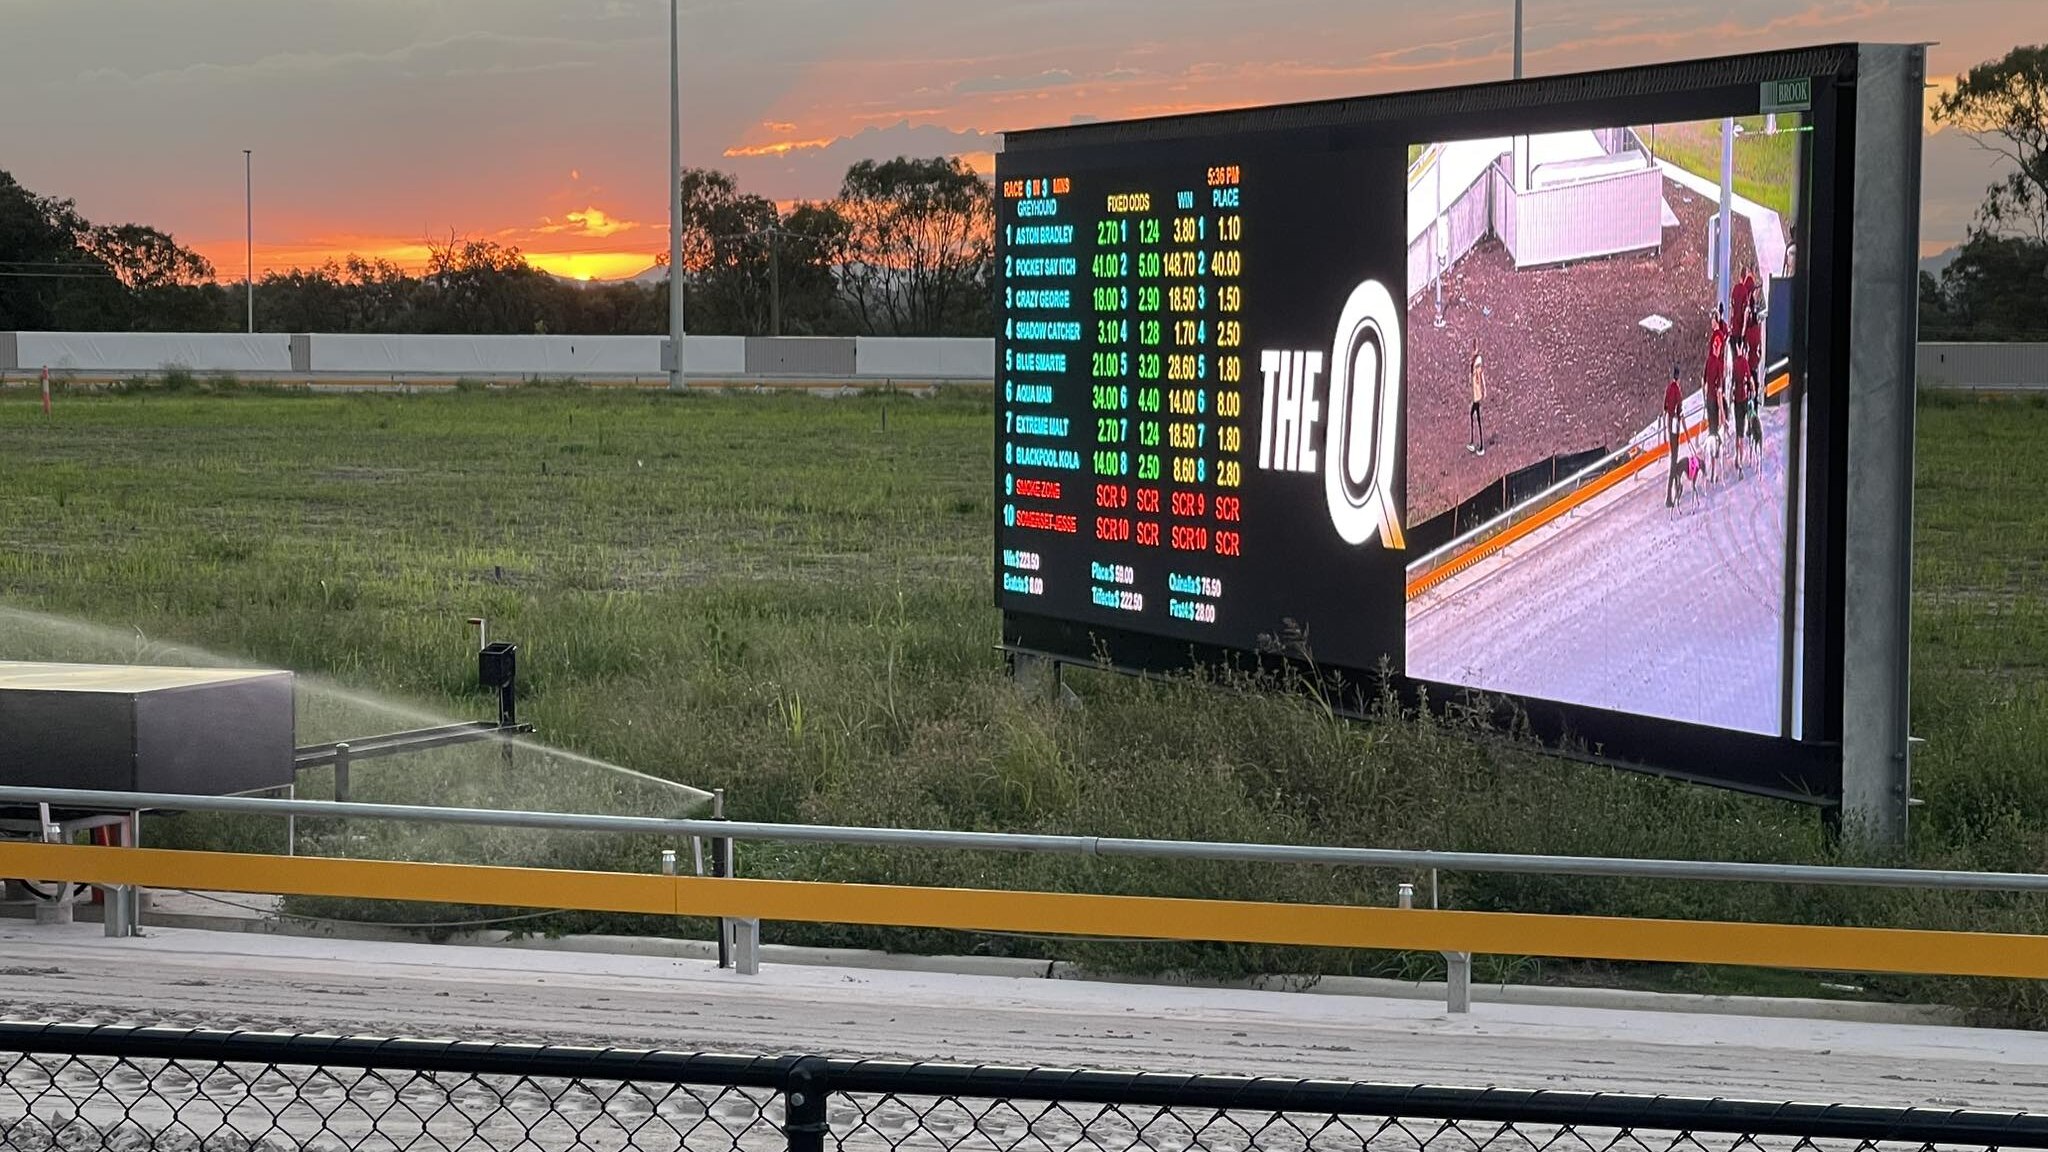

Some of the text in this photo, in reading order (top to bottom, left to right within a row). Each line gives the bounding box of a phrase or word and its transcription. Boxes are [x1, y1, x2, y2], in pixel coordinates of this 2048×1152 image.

[1779, 82, 1807, 102] BROOK
[1004, 180, 1023, 197] RACE
[1026, 180, 1031, 198] 6
[1042, 178, 1048, 198] 3
[1208, 166, 1240, 185] 5:36 PM
[1018, 199, 1056, 217] GREYHOUND
[1108, 193, 1149, 212] FIXED ODDS
[1178, 191, 1193, 208] WIN
[1213, 188, 1239, 207] PLACE
[1006, 215, 1240, 246] 1 ASTON BRADLEY 2.70 1 1.24 3.80 1 1.10
[1005, 251, 1240, 278] 2 POCKET SAY ITCH 41.00 2 5.00 148.70 2 40.00
[1006, 286, 1240, 311] 3 CRAZY GEORGE 18.00 3 2.90 18.50 3 1.50
[1005, 318, 1240, 346] 4 SHADOW CATCHER 3.10 4 1.28 1.70 4 2.50
[1006, 349, 1012, 371] 5
[1016, 353, 1035, 371] BLUE
[1093, 353, 1118, 377] 21.00
[1121, 352, 1127, 375] 5
[1139, 354, 1159, 378] 3.20
[1168, 355, 1195, 380] 28.60
[1198, 354, 1205, 378] 5
[1218, 356, 1240, 381] 1.80
[1006, 380, 1012, 402] 6
[1016, 385, 1036, 402] AQUA
[1093, 385, 1118, 410] 34.00
[1120, 386, 1127, 409] 6
[1138, 388, 1159, 412] 4.40
[1169, 390, 1195, 414] 14.00
[1198, 389, 1205, 413] 6
[1218, 391, 1240, 417] 8.00
[1258, 279, 1406, 550] THE Q
[1006, 411, 1012, 433] 7
[1016, 415, 1049, 435] EXTREME
[1098, 418, 1118, 442] 2.70
[1120, 418, 1127, 441] 7
[1140, 421, 1159, 445] 1.24
[1169, 423, 1195, 448] 18.50
[1198, 423, 1205, 447] 7
[1218, 426, 1240, 452] 1.80
[1006, 442, 1240, 487] 8 BLACKPOOL KOLA 14.00 8 2.50 8.60 8 2.80
[1006, 473, 1012, 495] 9
[1097, 484, 1119, 508] SCR
[1120, 486, 1127, 507] 9
[1137, 488, 1159, 512] SCR
[1172, 492, 1196, 516] SCR
[1197, 493, 1205, 515] 9
[1216, 496, 1239, 521] SCR
[1004, 504, 1015, 526] 10
[1096, 517, 1118, 540] SCR
[1118, 518, 1129, 540] 10
[1137, 522, 1159, 546] SCR
[1172, 526, 1195, 550] SCR
[1195, 528, 1207, 550] 10
[1215, 531, 1239, 556] SCR
